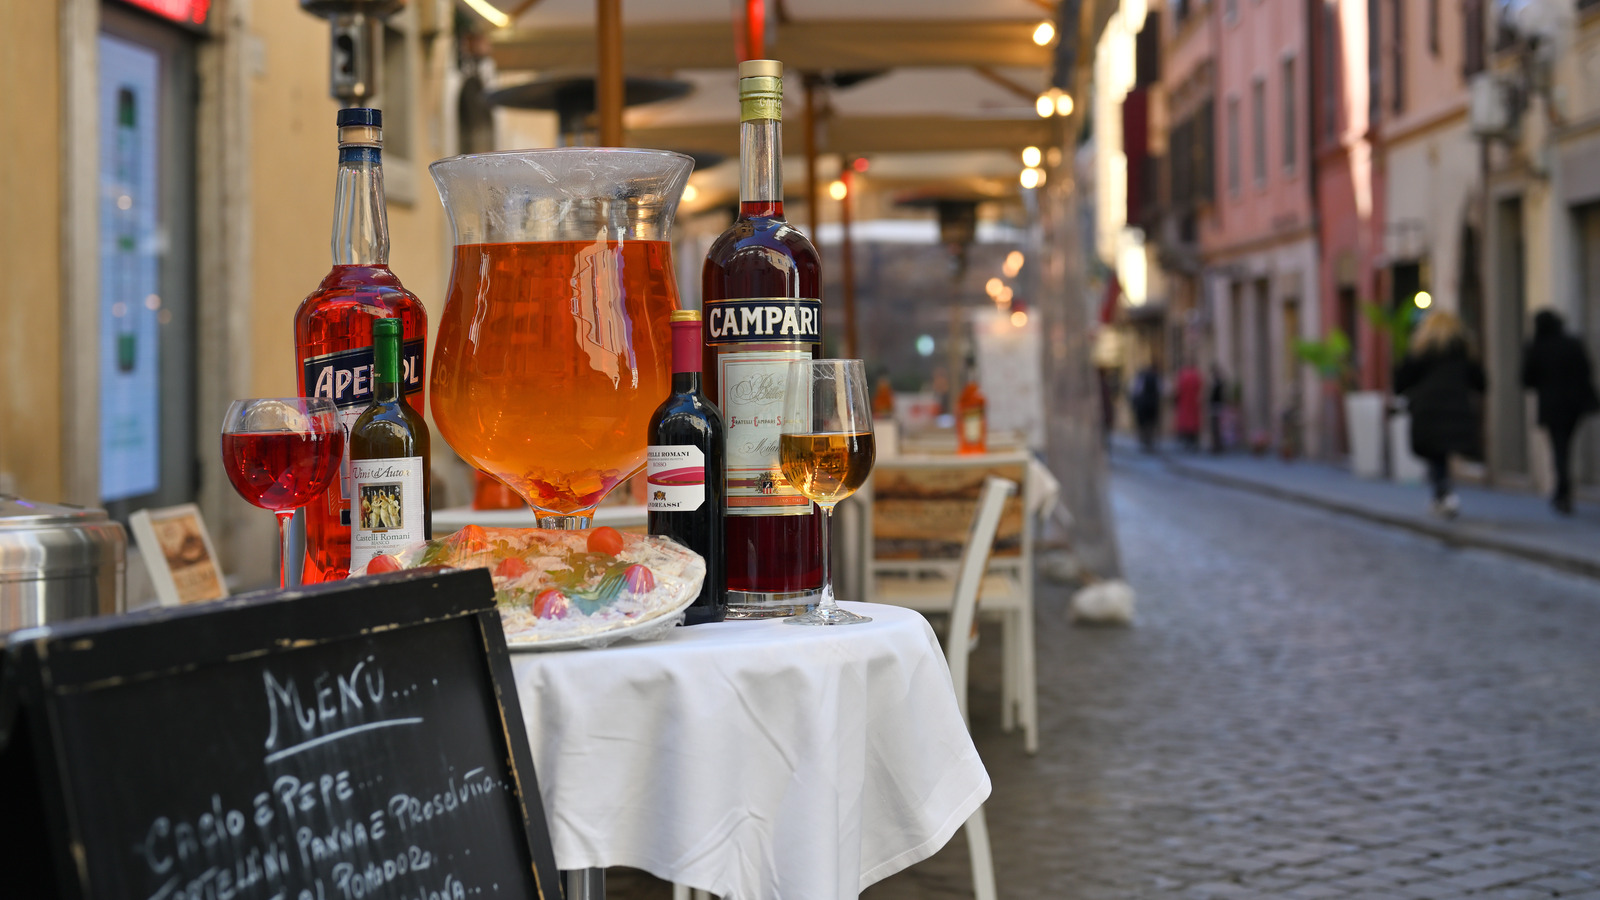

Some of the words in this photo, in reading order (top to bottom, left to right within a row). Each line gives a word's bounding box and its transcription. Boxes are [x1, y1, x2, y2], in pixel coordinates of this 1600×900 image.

[709, 306, 819, 338] CAMPARI
[355, 533, 378, 541] Castelli
[380, 532, 410, 540] Romani
